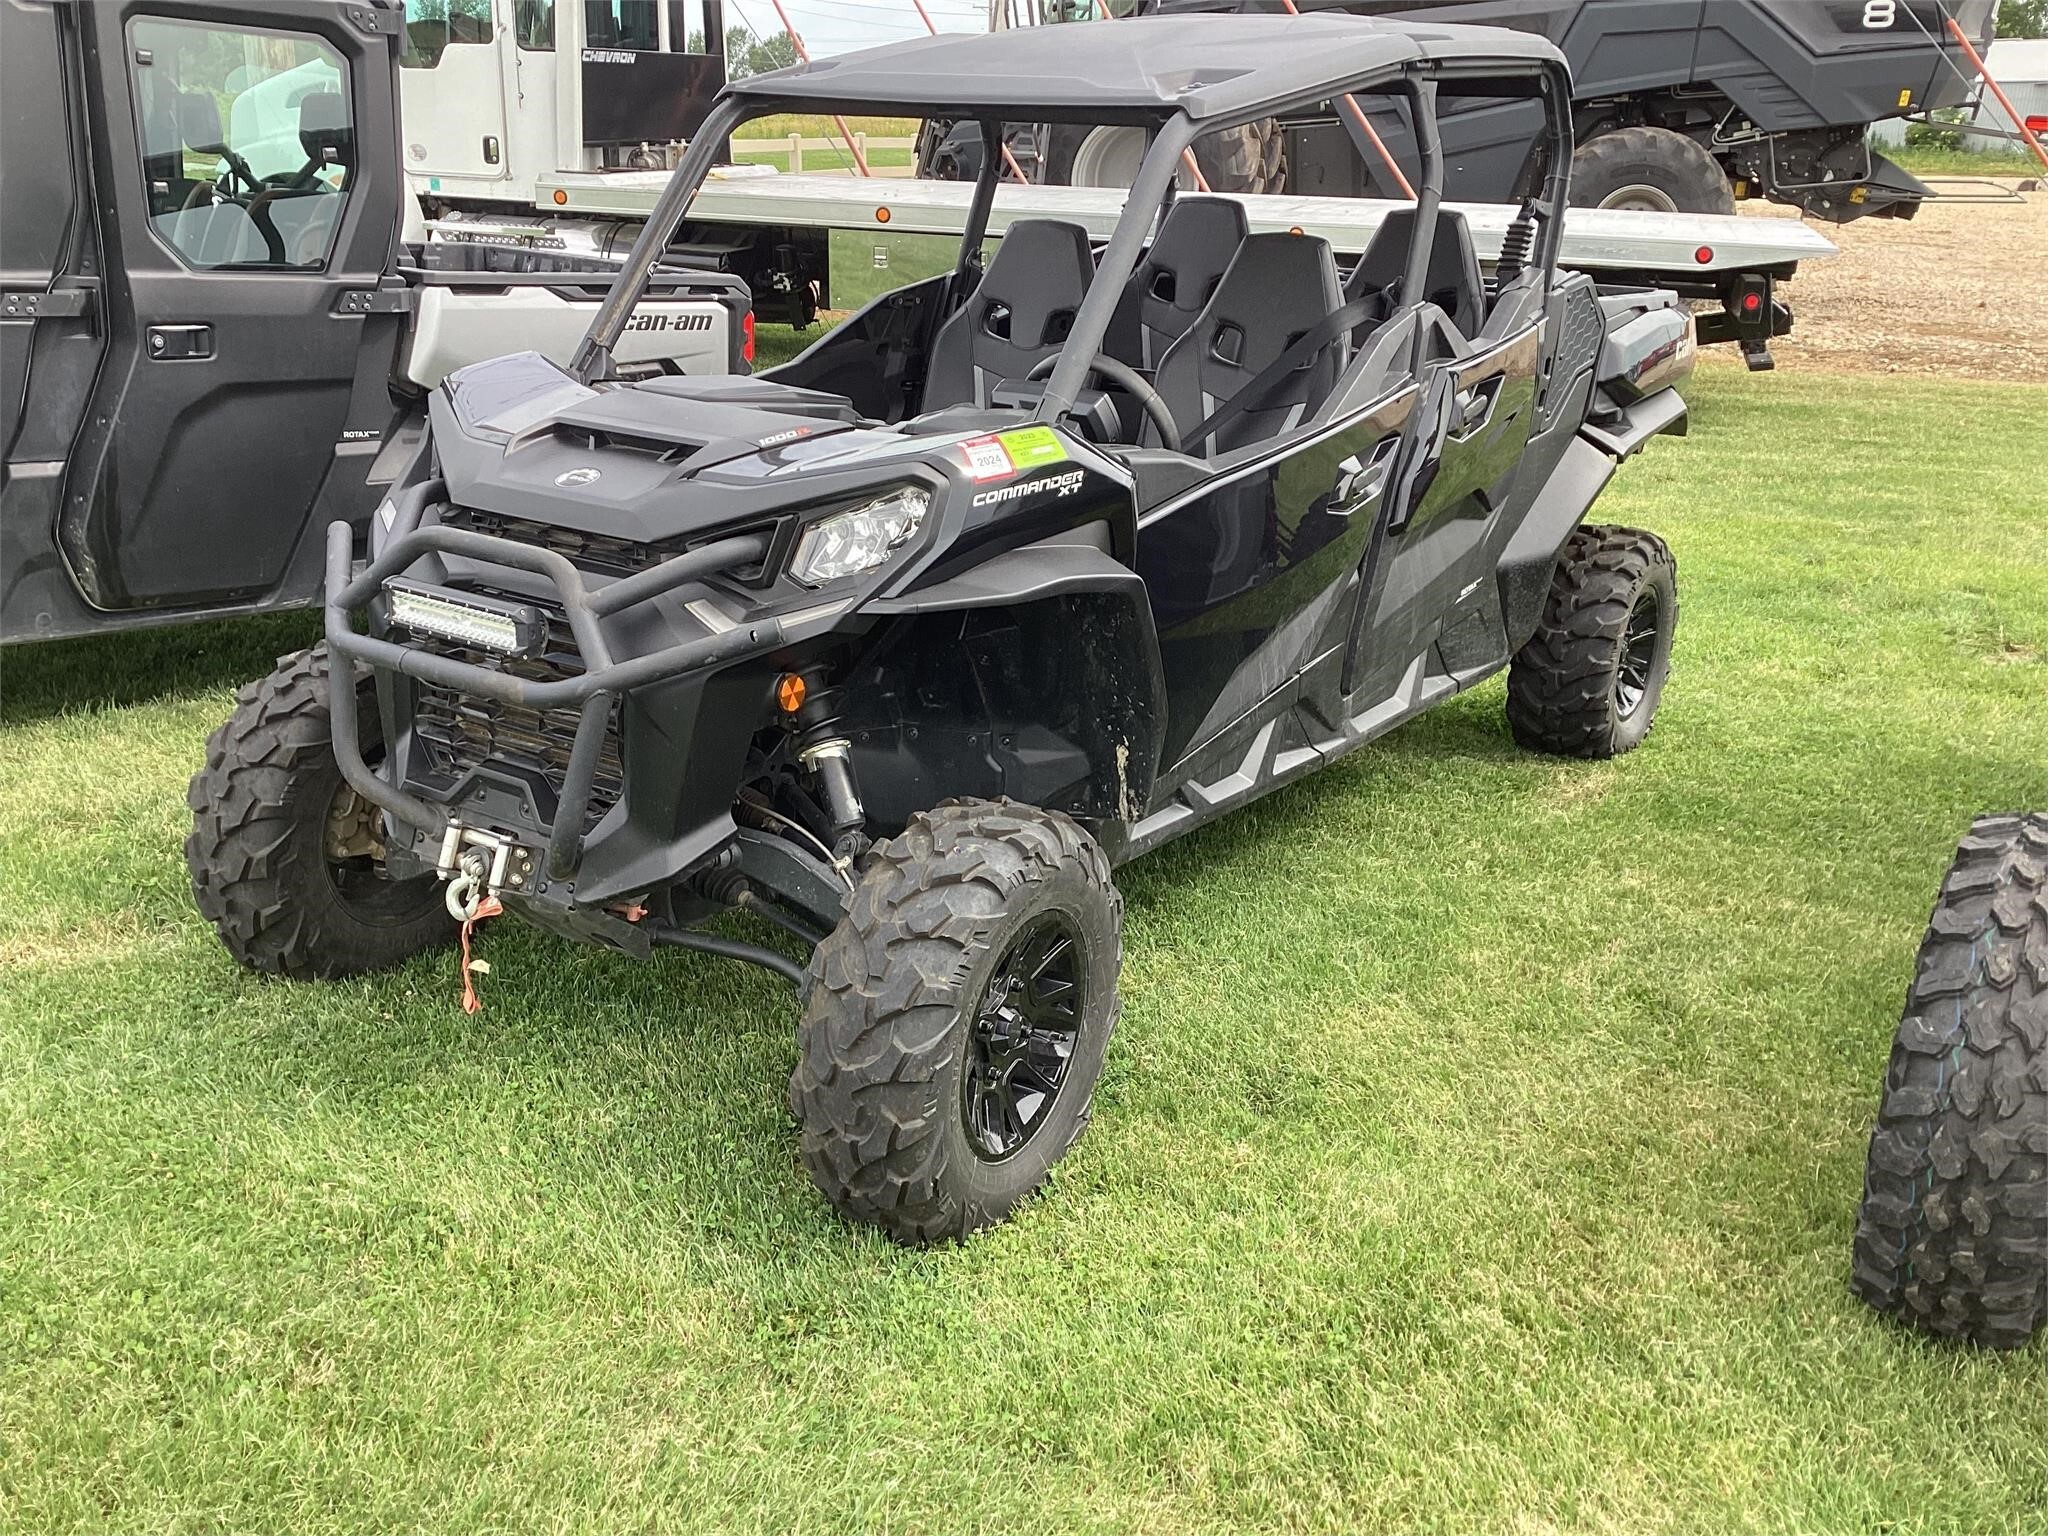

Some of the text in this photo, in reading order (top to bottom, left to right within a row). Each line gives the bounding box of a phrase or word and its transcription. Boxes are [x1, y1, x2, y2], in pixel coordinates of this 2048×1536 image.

[1862, 0, 1896, 28] 8
[582, 50, 636, 64] CHEVRON
[623, 314, 713, 331] can-am
[977, 454, 1002, 467] 2024
[972, 470, 1085, 507] COMMANDER
[1058, 482, 1083, 497] XT
